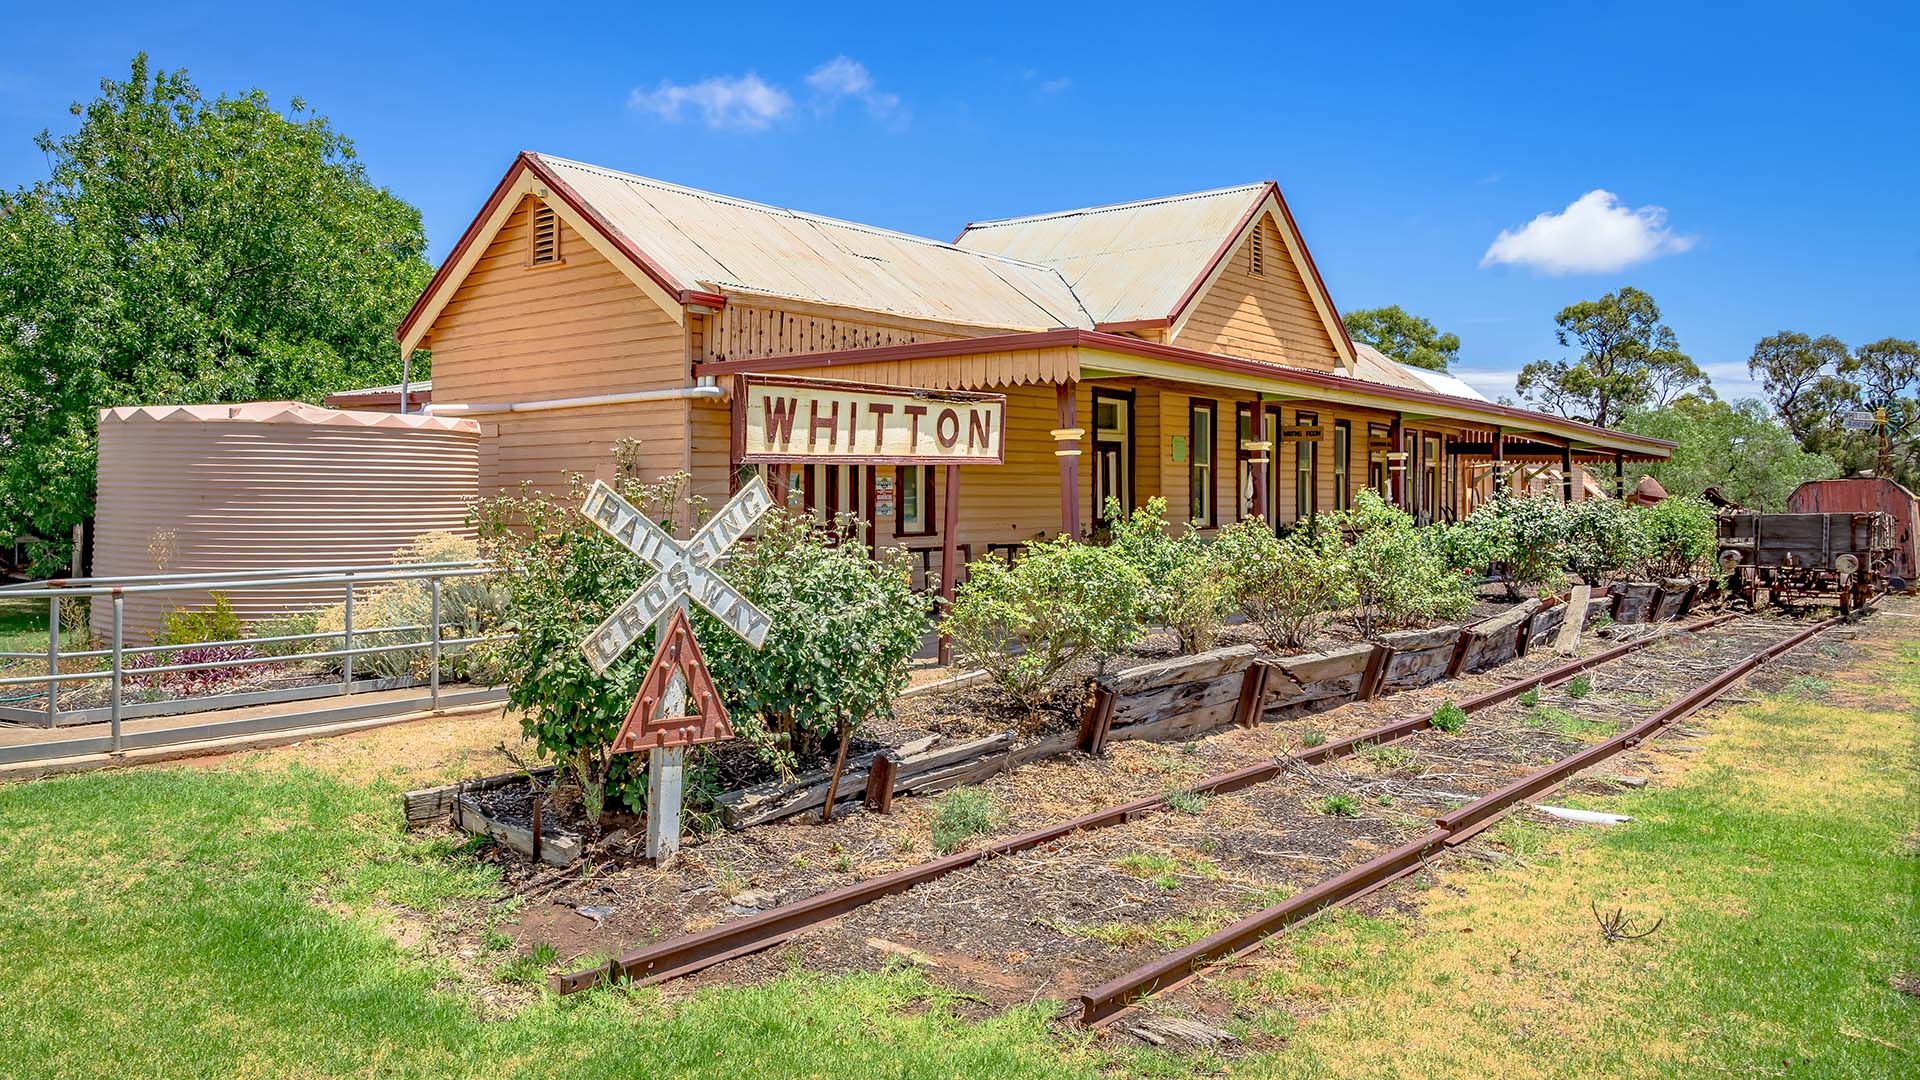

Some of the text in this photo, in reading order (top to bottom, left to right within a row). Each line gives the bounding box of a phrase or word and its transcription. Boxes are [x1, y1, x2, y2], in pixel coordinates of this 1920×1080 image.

[764, 396, 992, 449] WHITTON
[596, 493, 762, 637] RAILWAY
[597, 490, 762, 658] CROSSING
